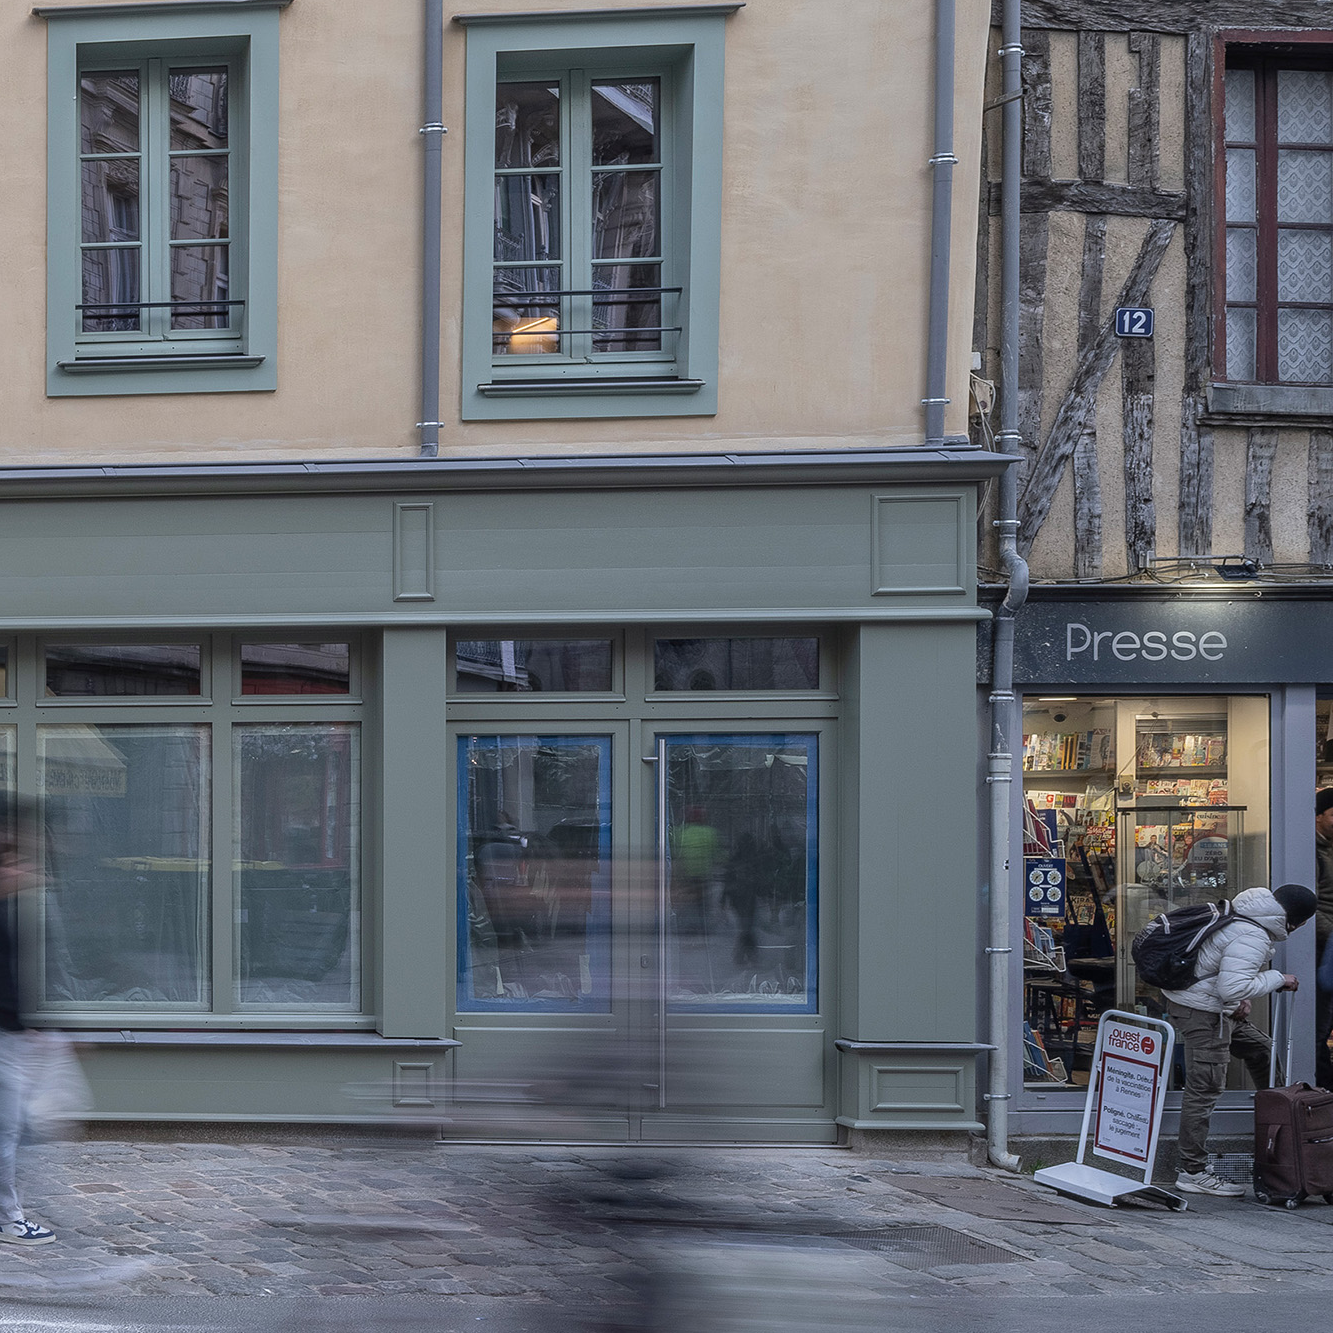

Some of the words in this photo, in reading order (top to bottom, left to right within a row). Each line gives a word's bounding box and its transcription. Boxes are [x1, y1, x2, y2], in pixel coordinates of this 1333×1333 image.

[1123, 311, 1146, 334] 12
[1066, 623, 1229, 661] Presse
[1108, 1034, 1140, 1052] france
[1112, 1028, 1140, 1043] ouest
